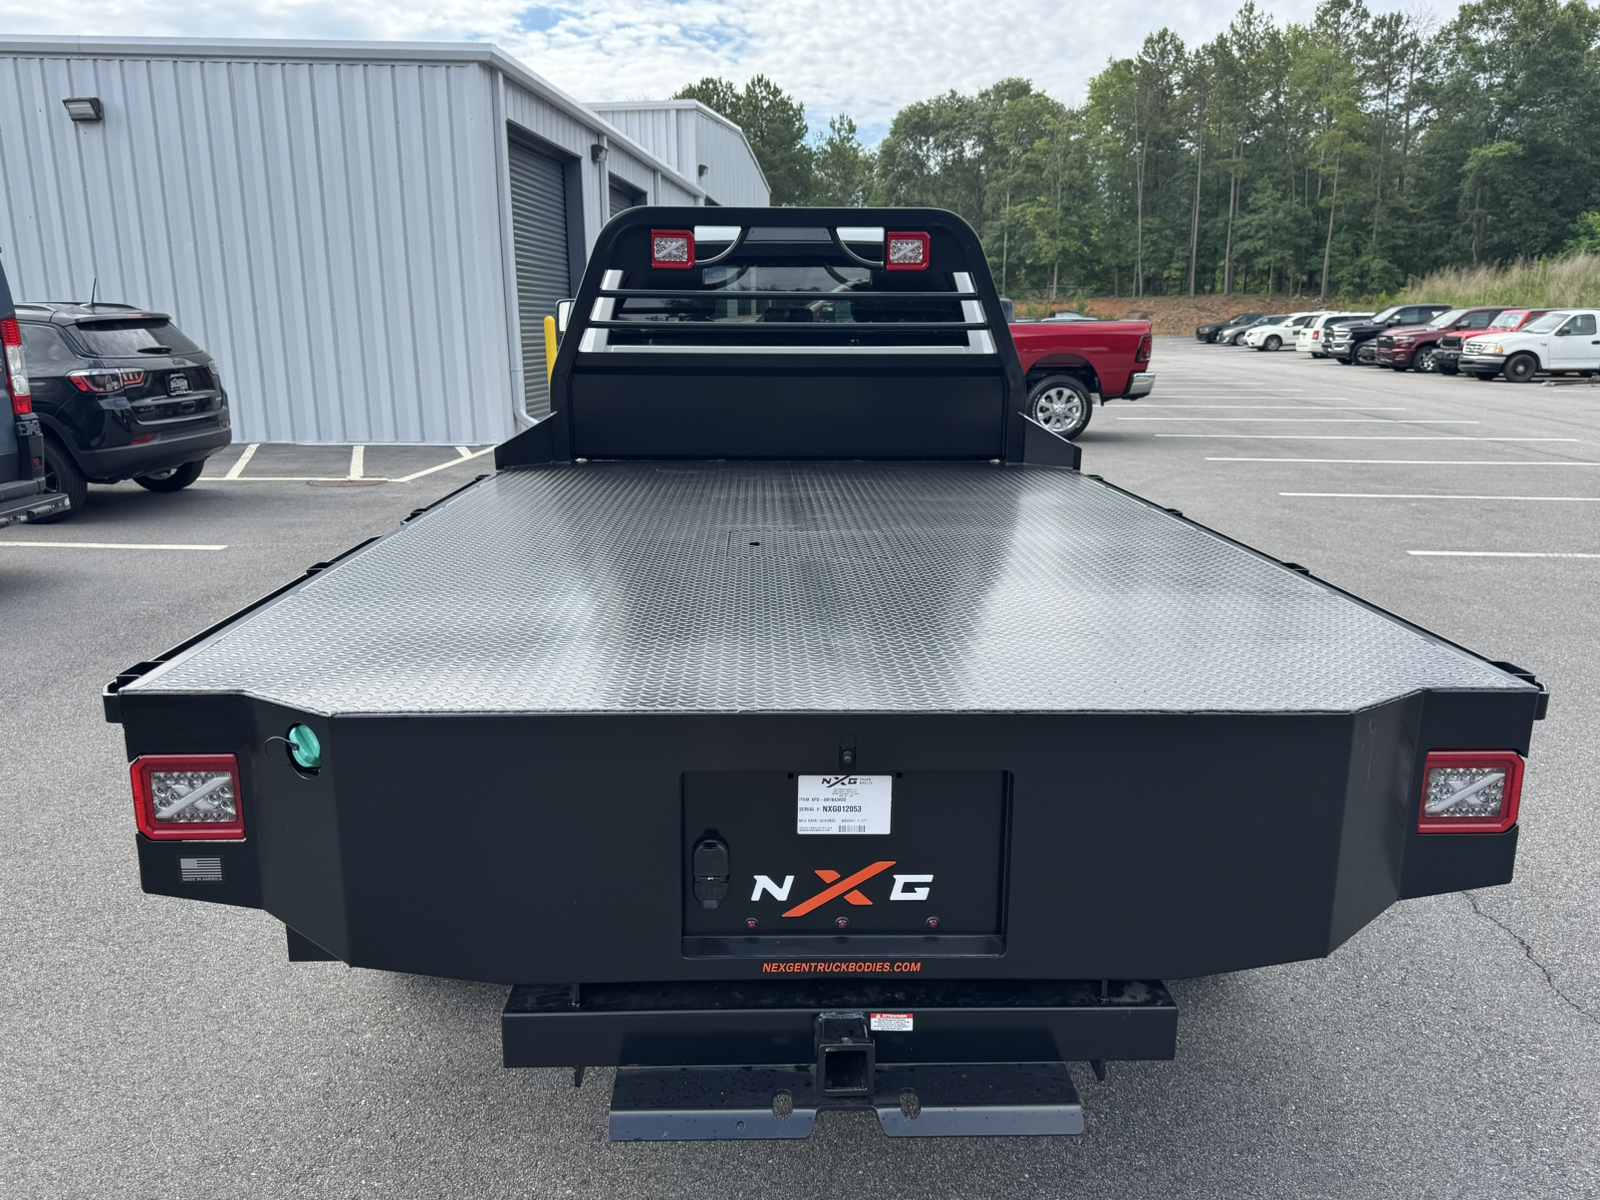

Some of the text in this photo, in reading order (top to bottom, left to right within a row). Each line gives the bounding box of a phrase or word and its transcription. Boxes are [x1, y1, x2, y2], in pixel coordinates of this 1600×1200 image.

[821, 774, 859, 788] NXG
[822, 805, 862, 813] NXG012053
[750, 860, 934, 918] NXG
[762, 962, 922, 973] NEXGENTRUCKBODIES.COM
